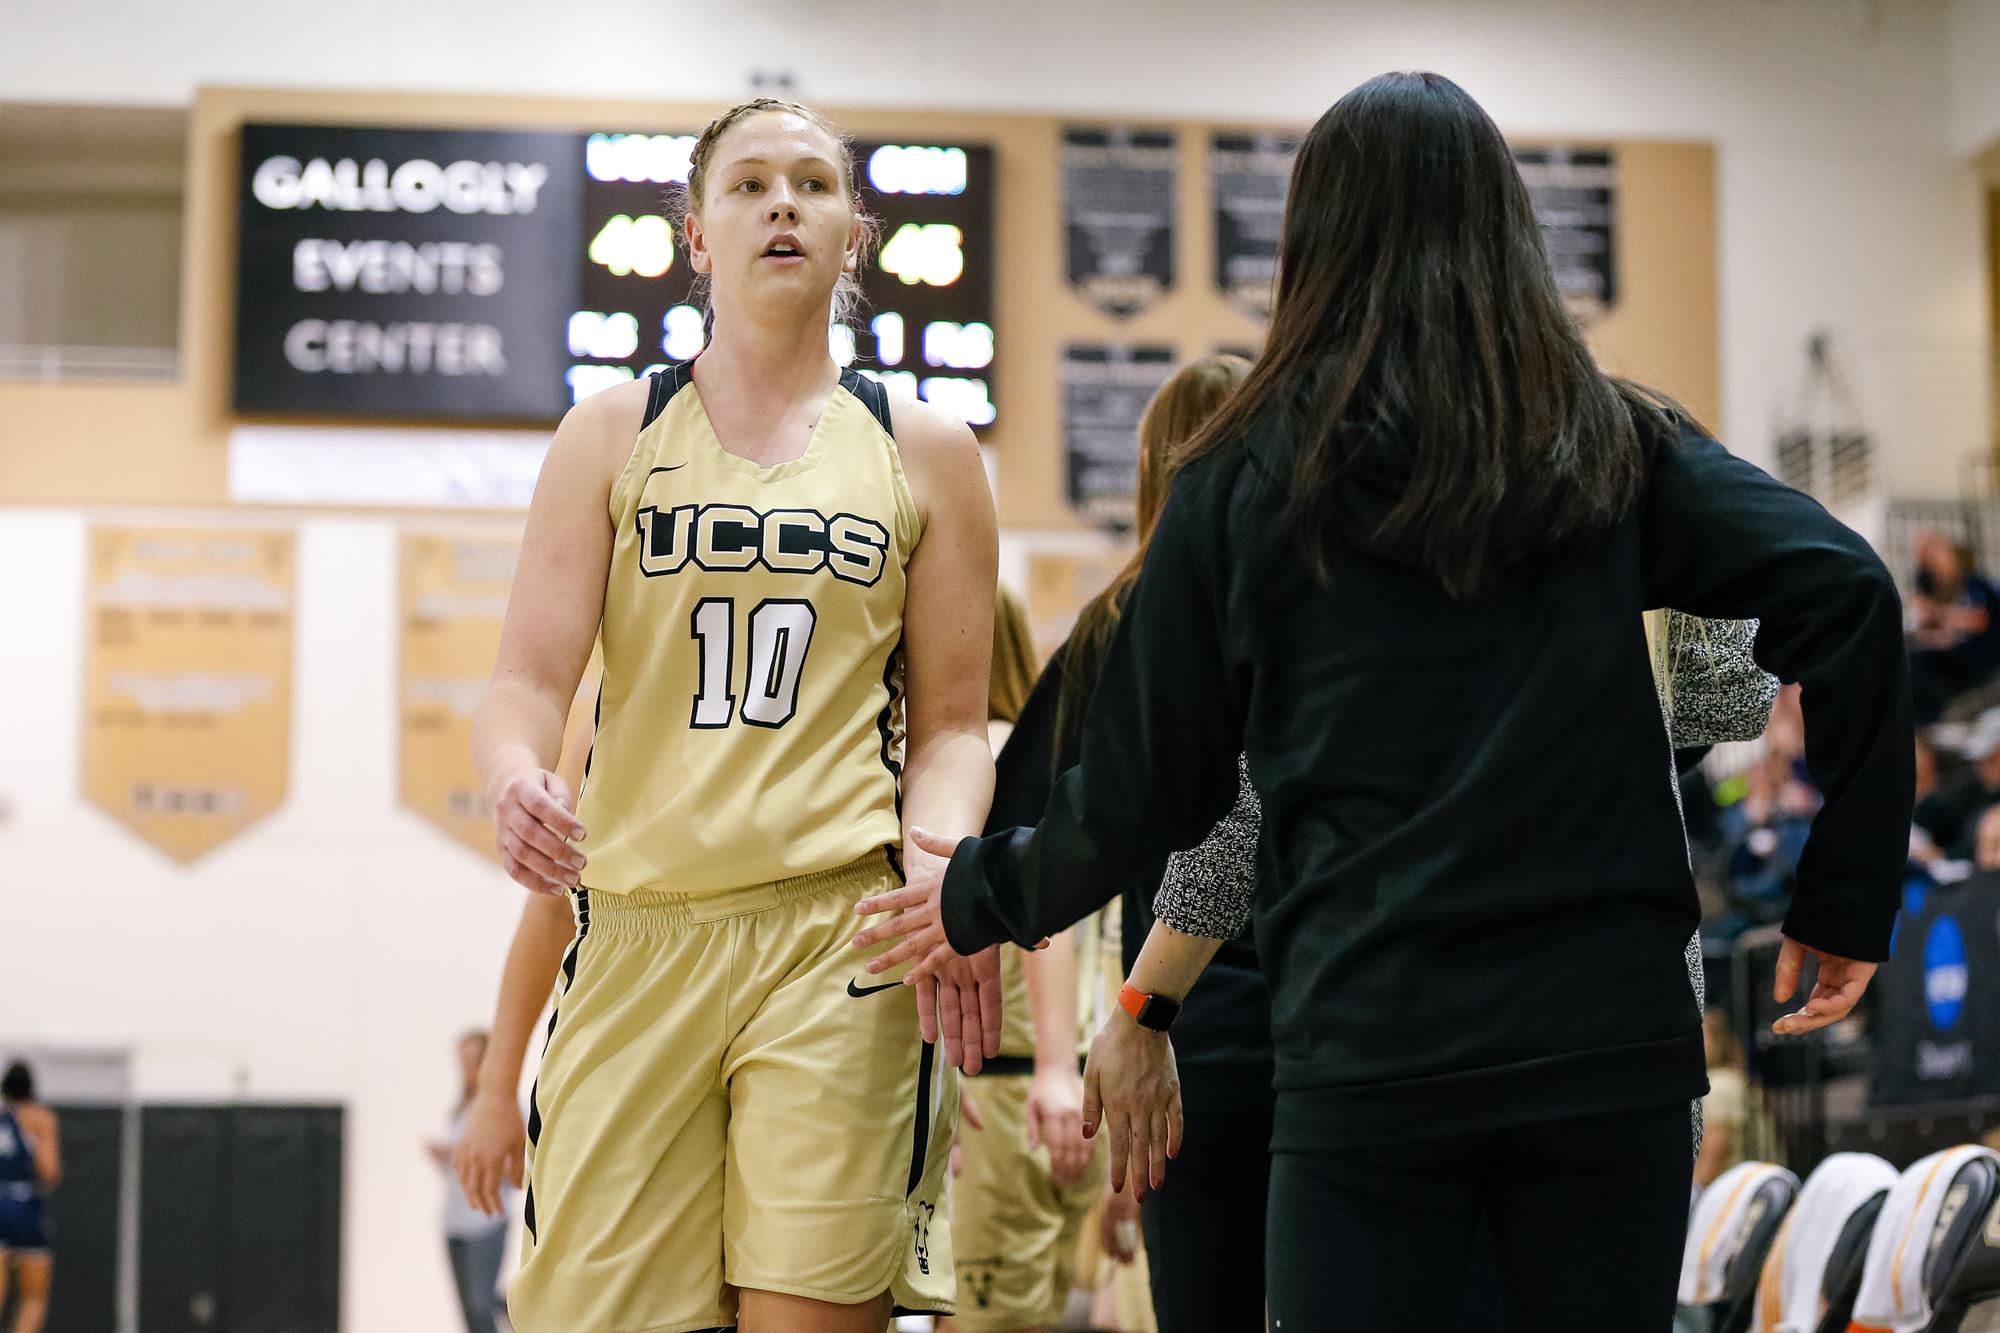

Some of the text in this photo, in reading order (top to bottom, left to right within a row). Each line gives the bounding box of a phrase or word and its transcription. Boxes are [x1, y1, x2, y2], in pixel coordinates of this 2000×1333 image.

[253, 155, 547, 214] GALLOGLY
[294, 238, 503, 295] EVENTS
[284, 318, 507, 376] CENTER
[636, 503, 890, 588] UCCS
[689, 597, 817, 729] 10
